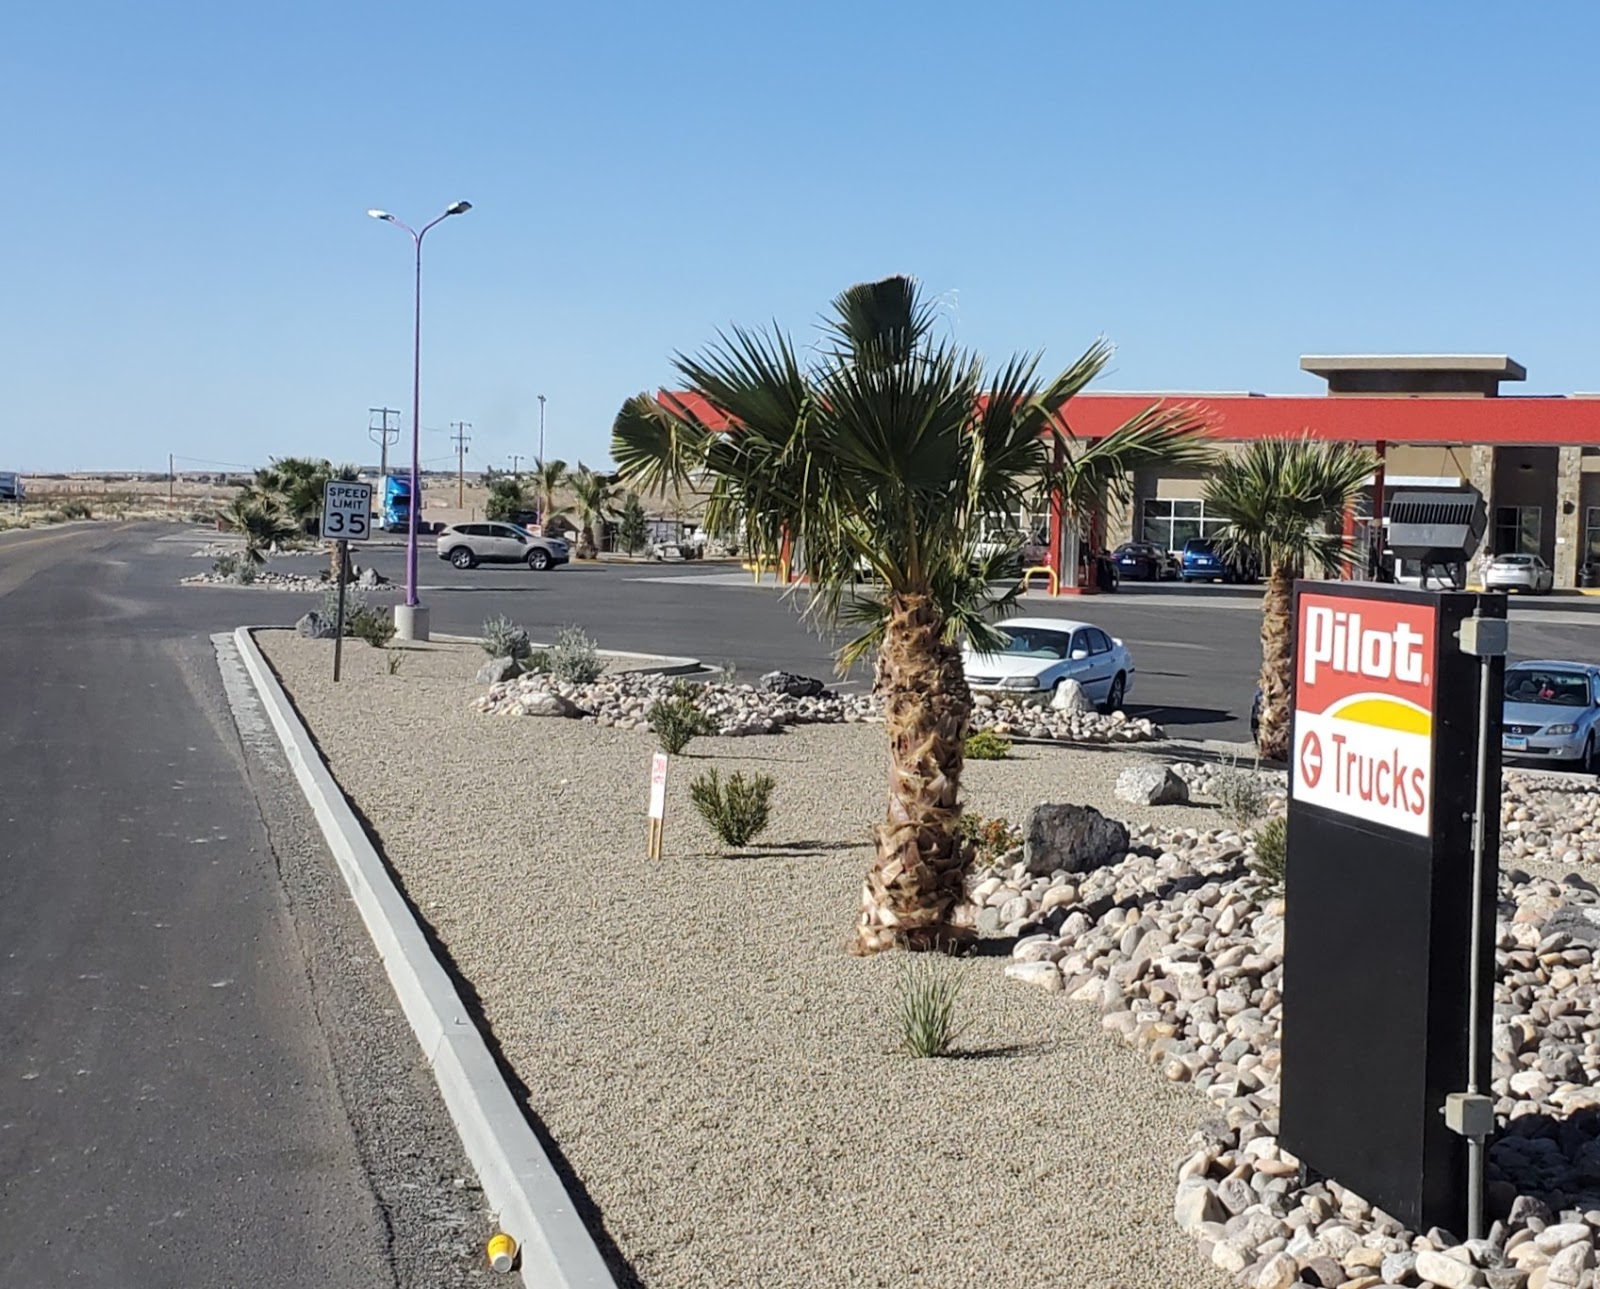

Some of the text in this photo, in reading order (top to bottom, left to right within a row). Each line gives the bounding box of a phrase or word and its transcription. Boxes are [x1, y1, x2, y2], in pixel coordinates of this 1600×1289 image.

[329, 487, 368, 499] SPEED
[332, 498, 363, 510] LIMIT
[328, 512, 365, 534] 35
[1332, 733, 1425, 816] Trucks
